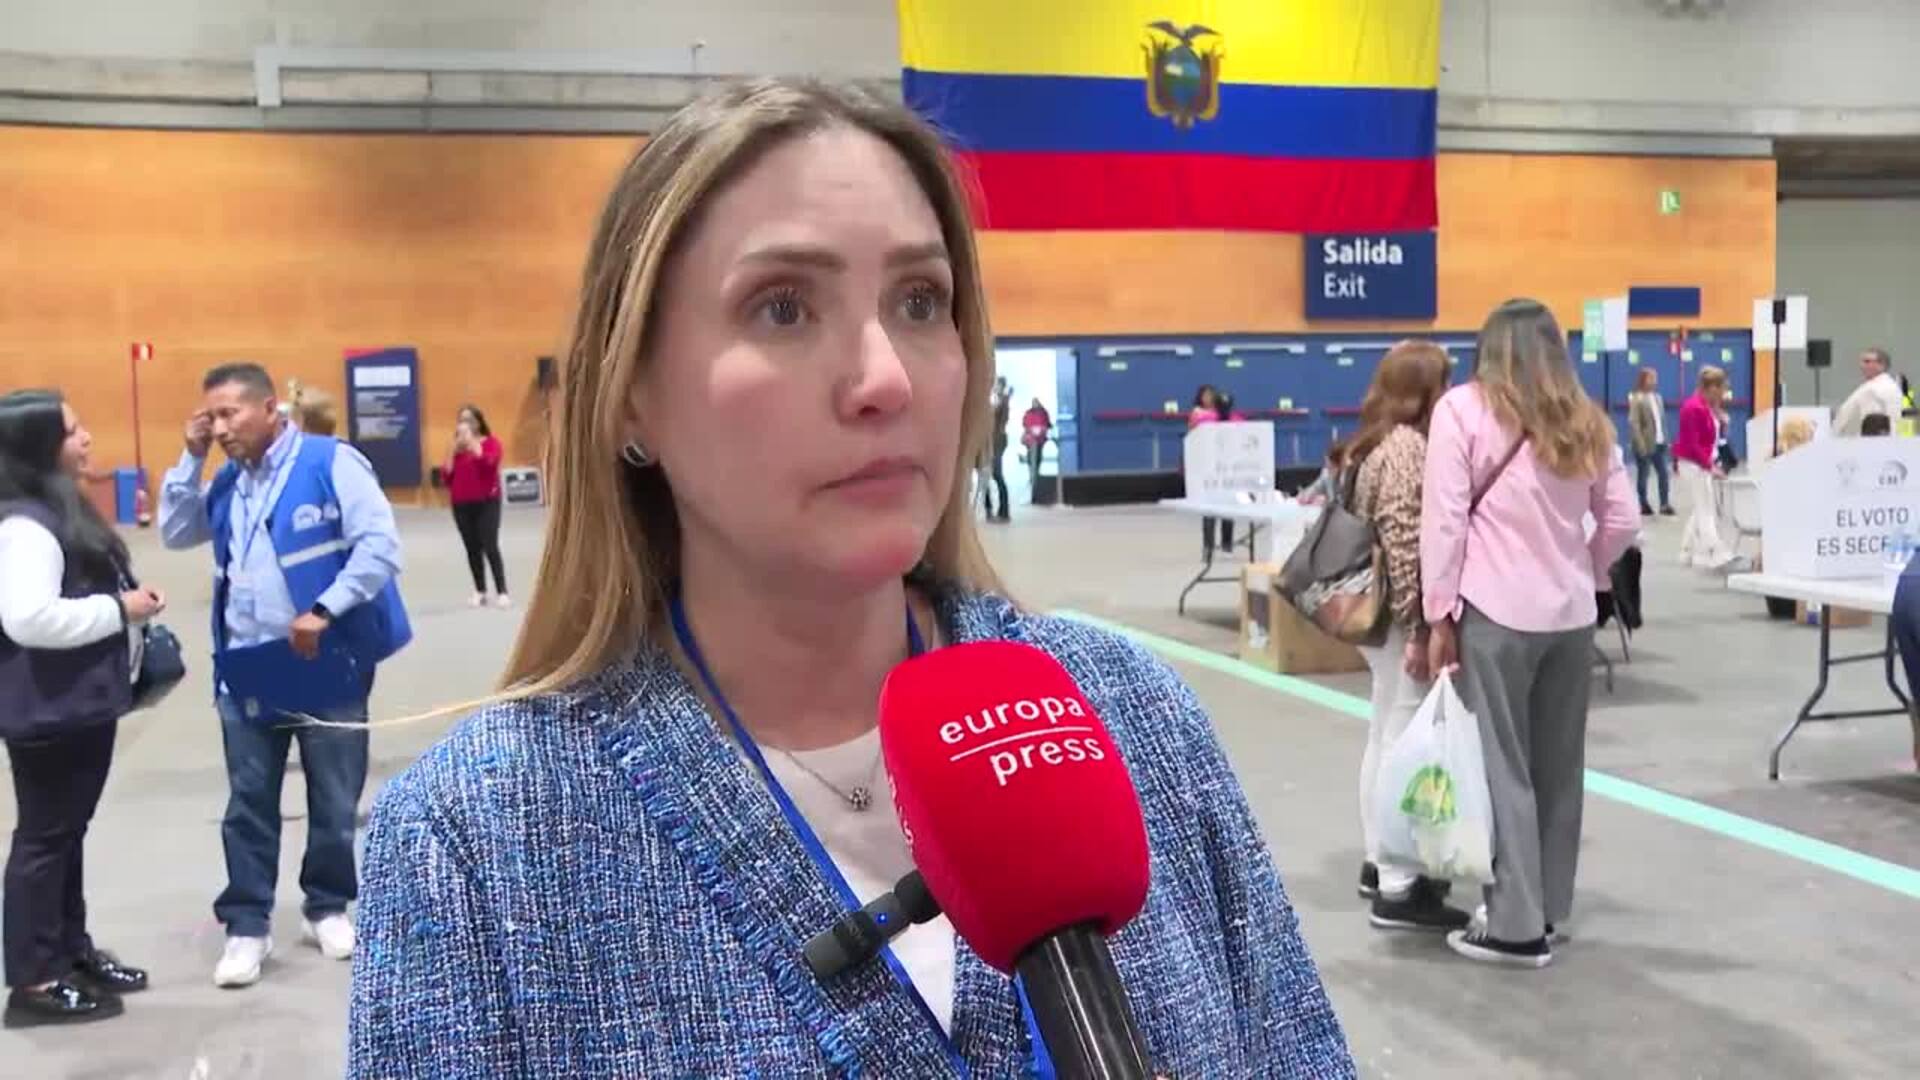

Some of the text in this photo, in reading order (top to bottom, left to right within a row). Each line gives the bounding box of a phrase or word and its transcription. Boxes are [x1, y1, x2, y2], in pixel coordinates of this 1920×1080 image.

[1323, 238, 1403, 265] Salida
[1323, 271, 1367, 299] Exit
[1836, 507, 1909, 528] EL VOTO
[1817, 537, 1841, 556] ES
[939, 696, 1086, 744] europa
[990, 738, 1106, 787] press
